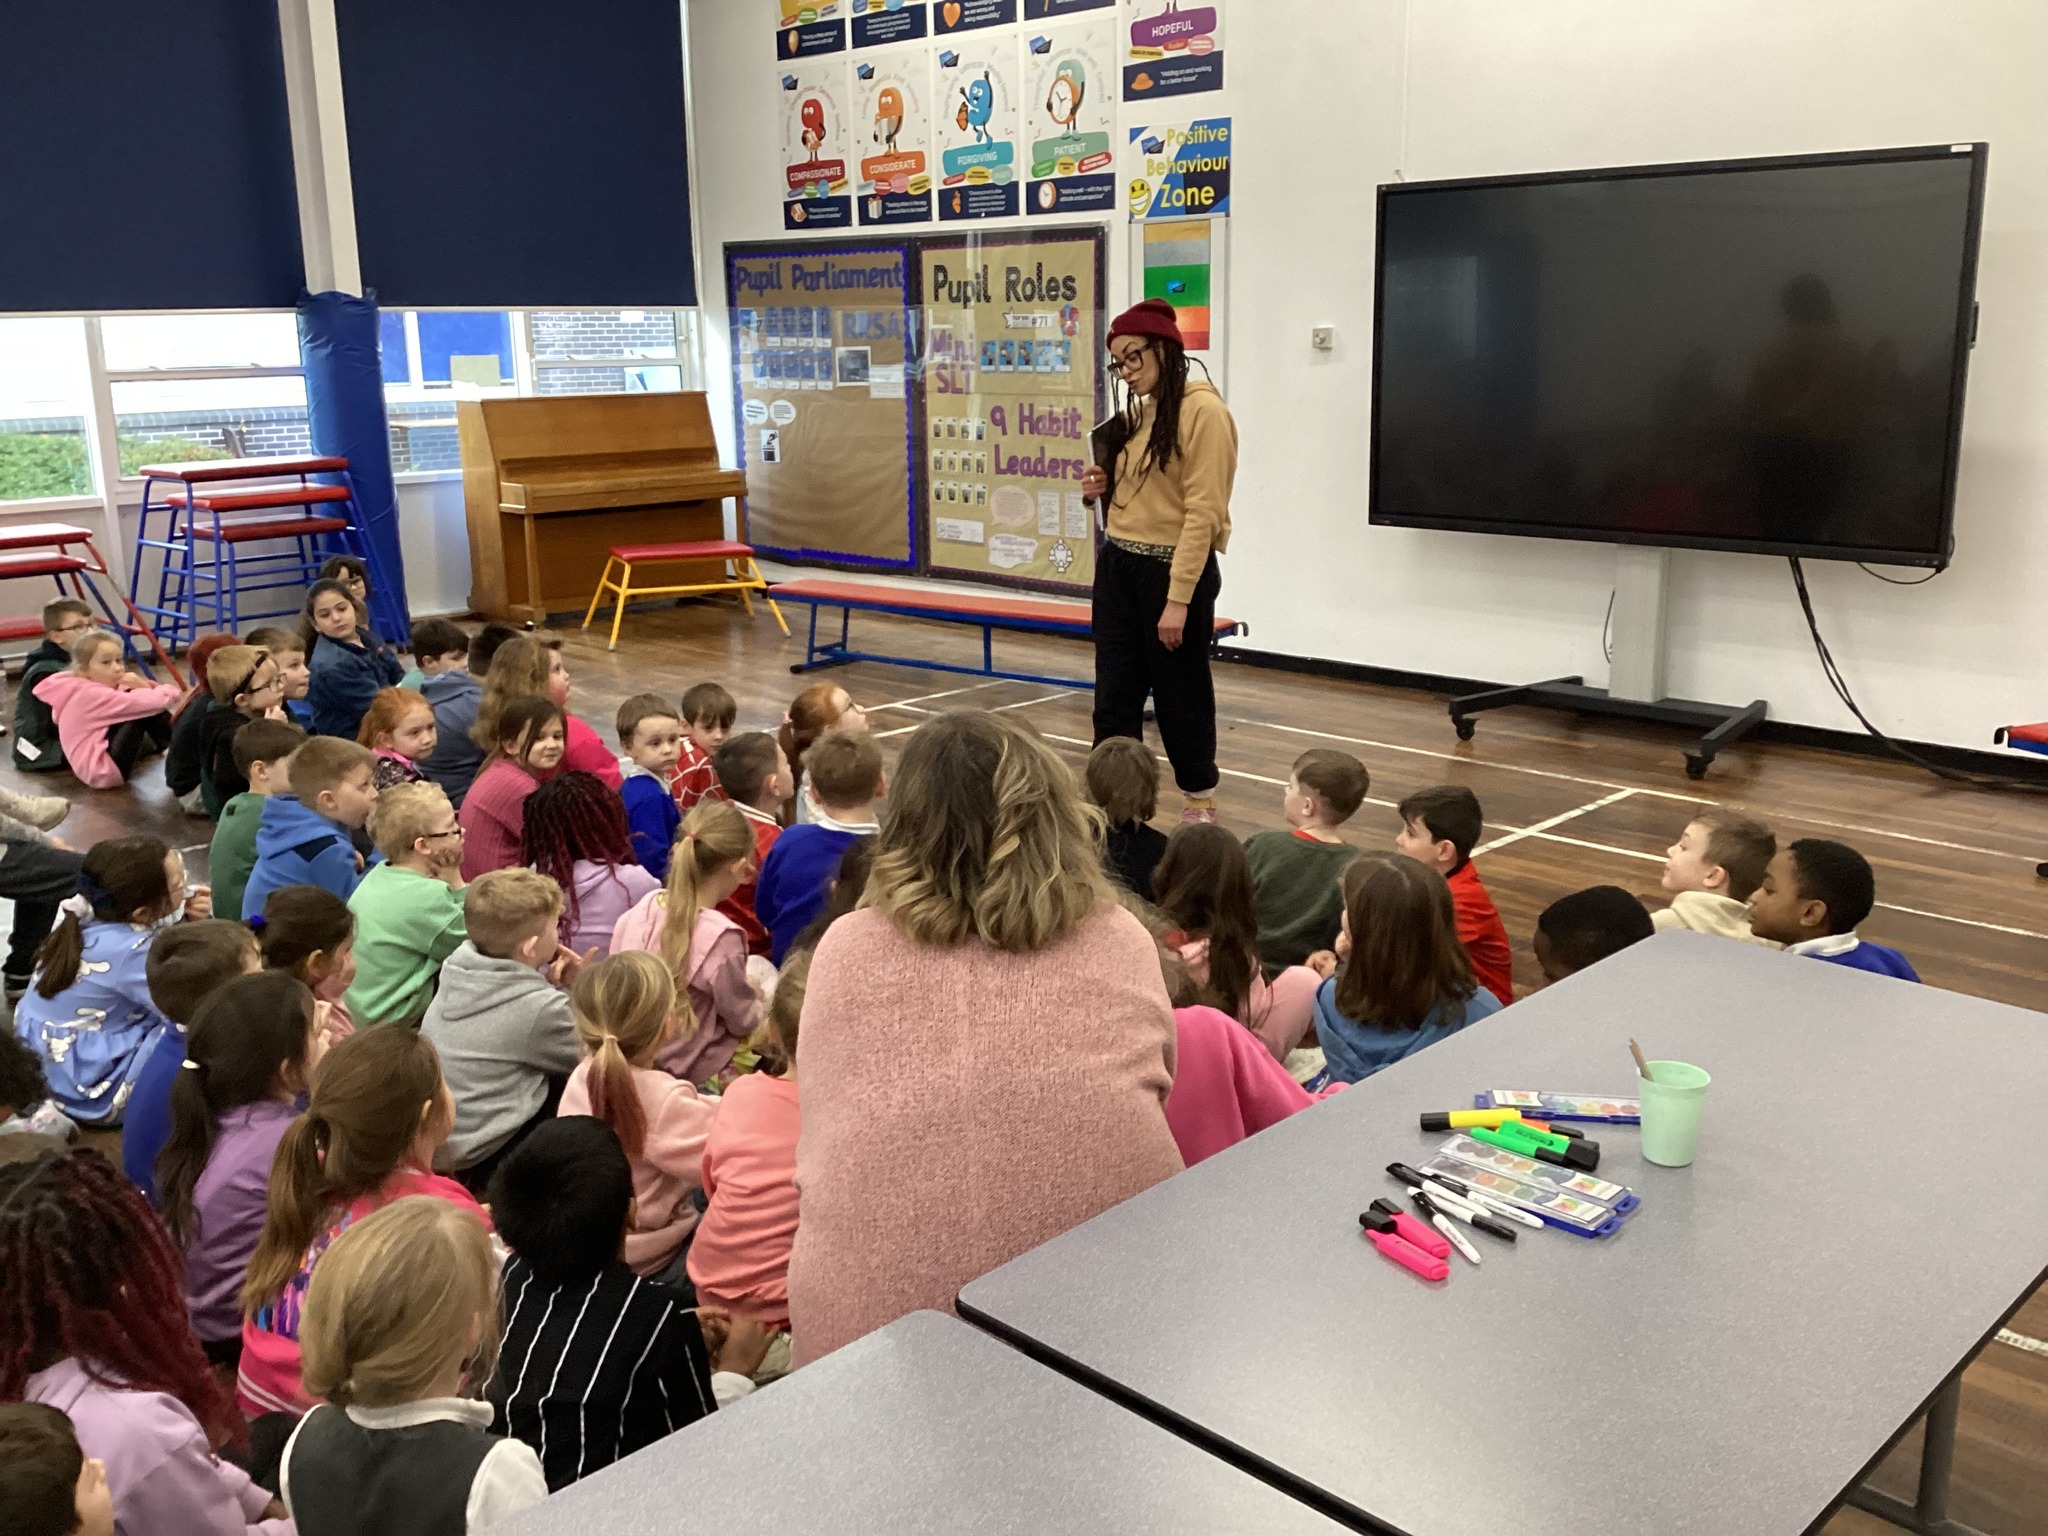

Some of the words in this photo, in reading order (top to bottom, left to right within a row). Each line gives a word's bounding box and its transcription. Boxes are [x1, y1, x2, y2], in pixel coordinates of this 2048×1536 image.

[1152, 20, 1194, 37] HOPEFUL
[1166, 124, 1229, 147] Positive
[957, 151, 998, 166] FORGIVING
[1054, 142, 1087, 156] PATIENT
[789, 166, 842, 181] COMPASSIONATE
[869, 159, 917, 175] CONSIDERATE
[1146, 153, 1229, 177] Behaviour
[1160, 183, 1215, 208] Zone
[736, 261, 783, 297] Pupil
[792, 260, 903, 291] Parliament
[933, 264, 991, 309] Pupil
[1005, 262, 1077, 302] Roles
[929, 329, 976, 362] Mini
[935, 363, 975, 395] SLT
[991, 405, 1008, 436] 9
[1019, 403, 1082, 439] Habit
[994, 444, 1084, 480] Leaders
